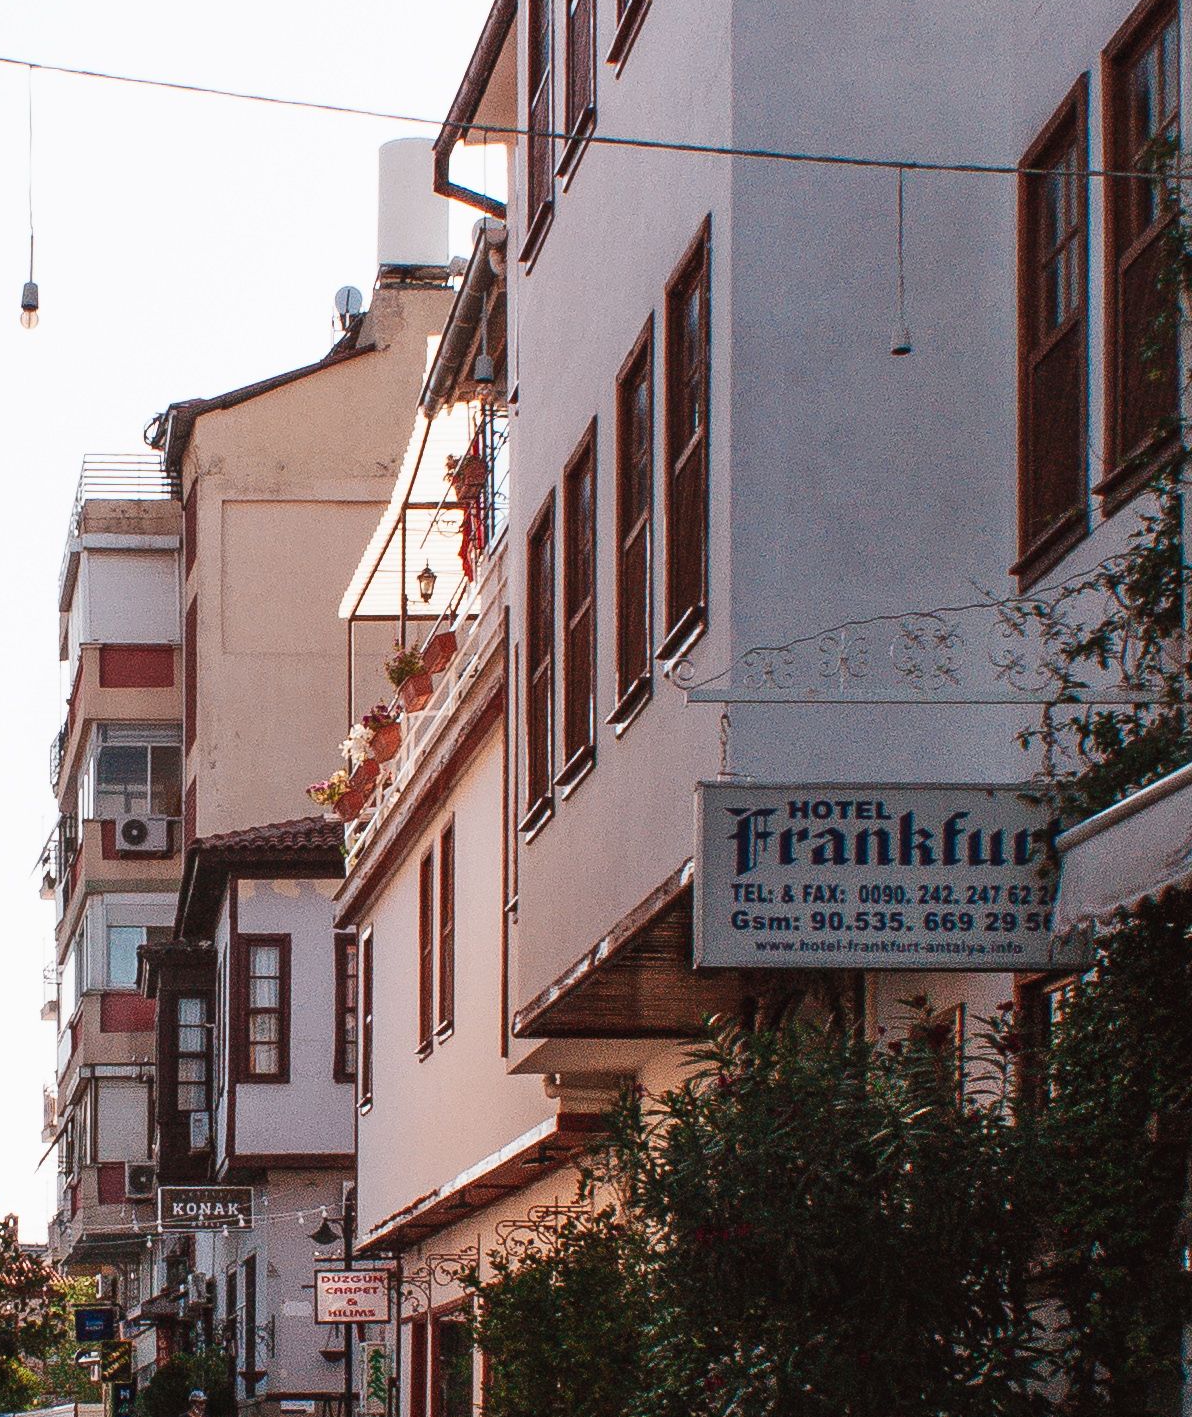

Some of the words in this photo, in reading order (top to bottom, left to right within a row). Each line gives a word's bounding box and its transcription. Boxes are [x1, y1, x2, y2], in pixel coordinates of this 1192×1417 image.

[787, 800, 892, 820] HOTEL
[731, 884, 774, 904] TEL:
[780, 884, 796, 904] &
[802, 884, 847, 904] FAX:
[859, 884, 913, 904] 0090.
[917, 884, 961, 905] 242.
[966, 884, 1000, 905] 247
[1007, 885, 1033, 905] 62
[730, 911, 801, 932] Gsm:
[923, 911, 974, 932] 669
[983, 911, 1019, 932] 29
[172, 1202, 239, 1216] KONAK
[325, 1286, 380, 1295] CARPET
